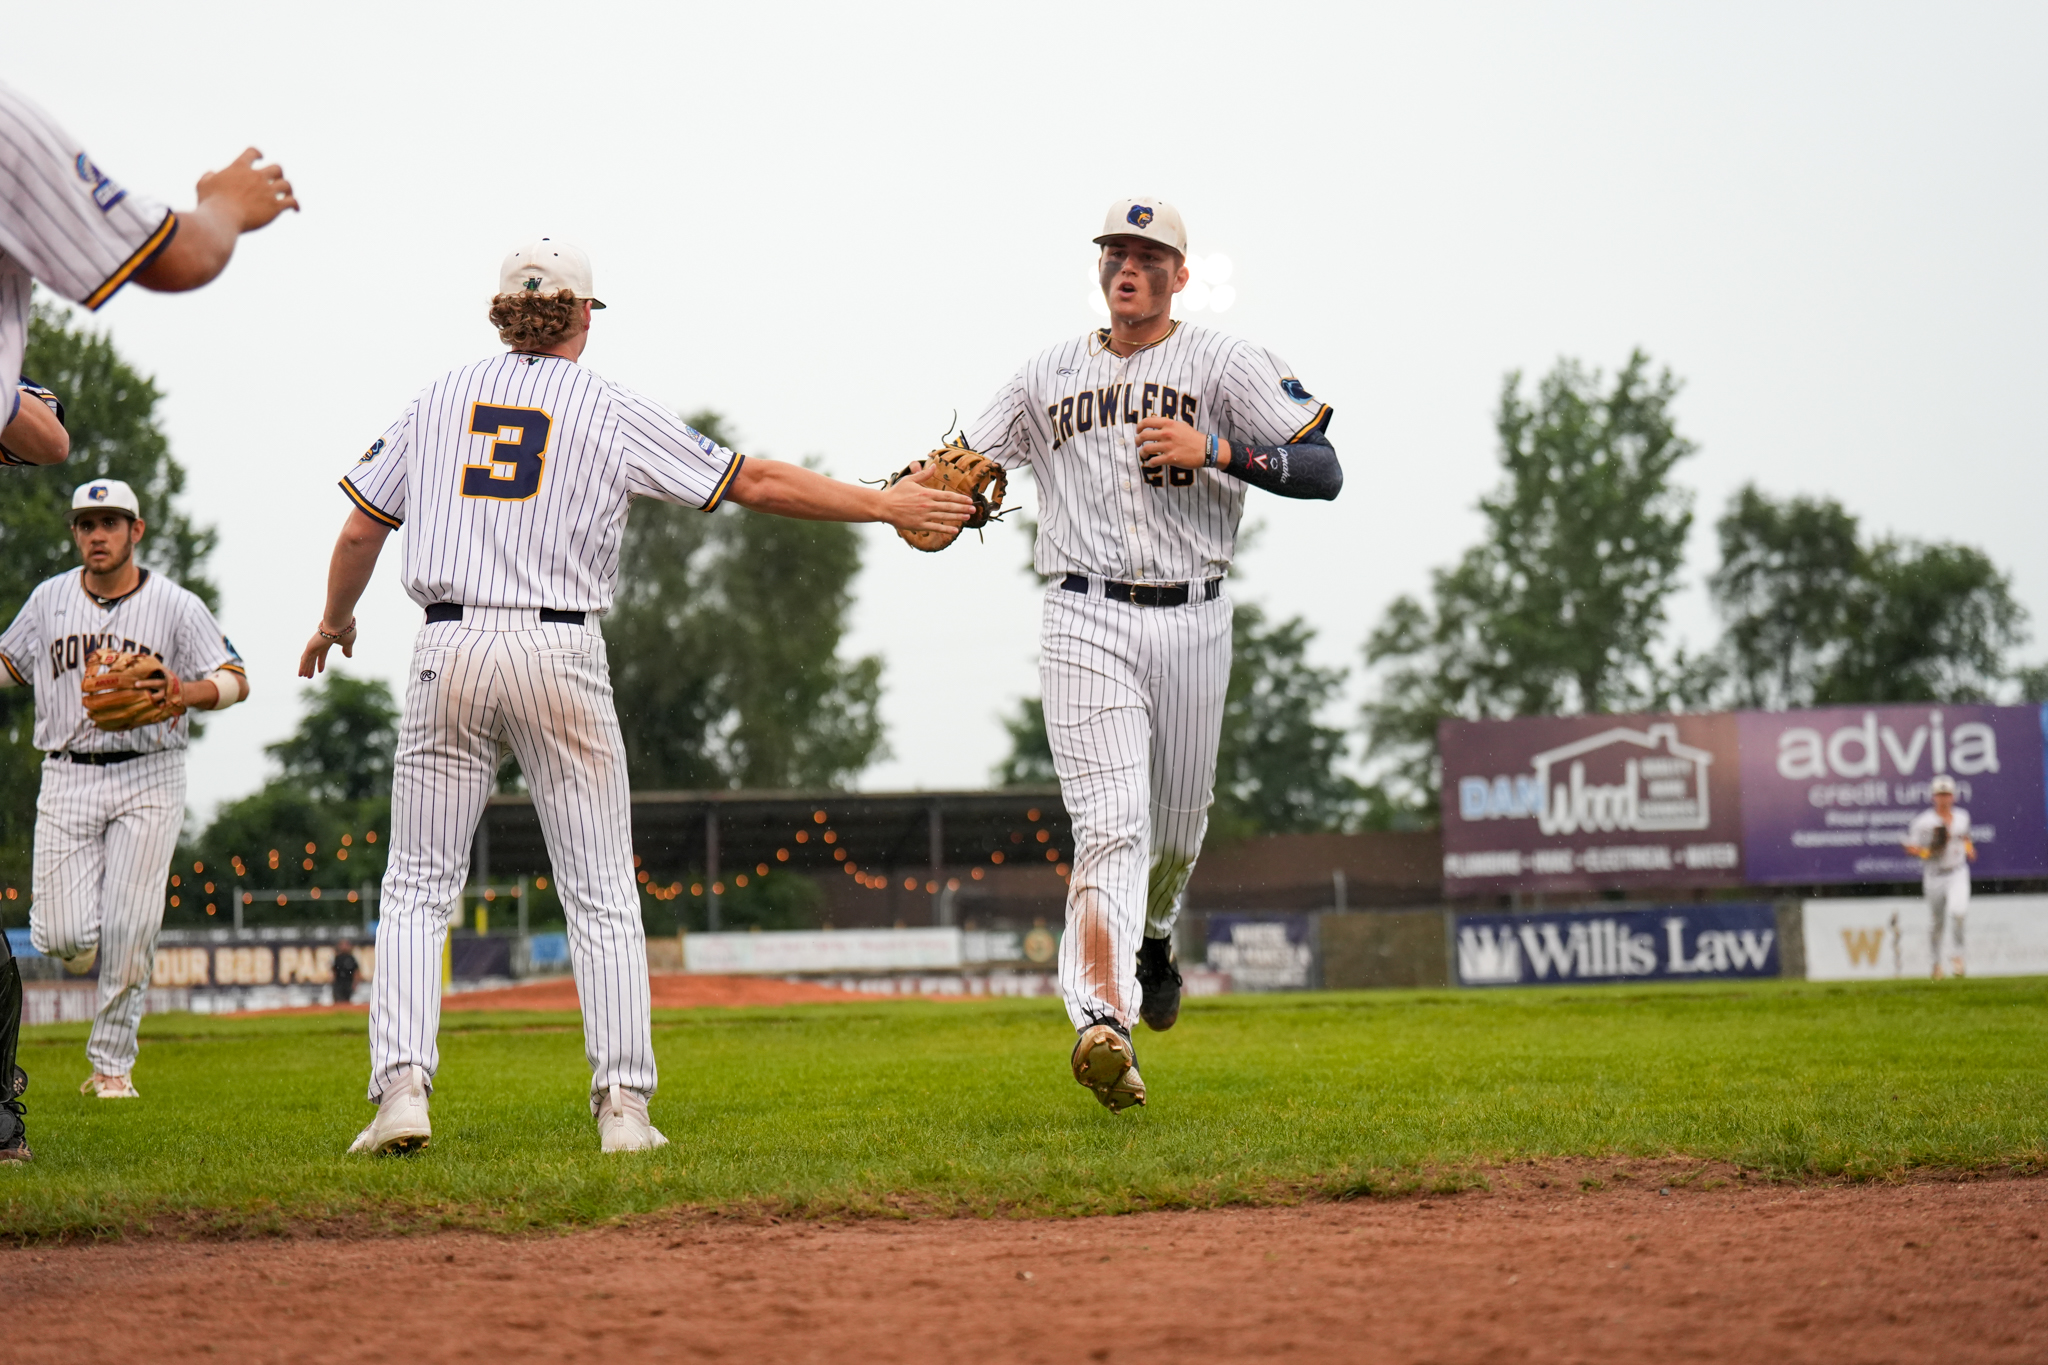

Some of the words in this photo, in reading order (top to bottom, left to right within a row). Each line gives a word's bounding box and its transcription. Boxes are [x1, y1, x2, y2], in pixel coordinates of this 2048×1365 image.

[460, 401, 553, 502] 3
[1776, 709, 2001, 780] advia
[1808, 781, 1889, 808] credit
[1895, 780, 1973, 805] unn
[1519, 917, 1658, 980] Willis
[1664, 915, 1775, 974] Law
